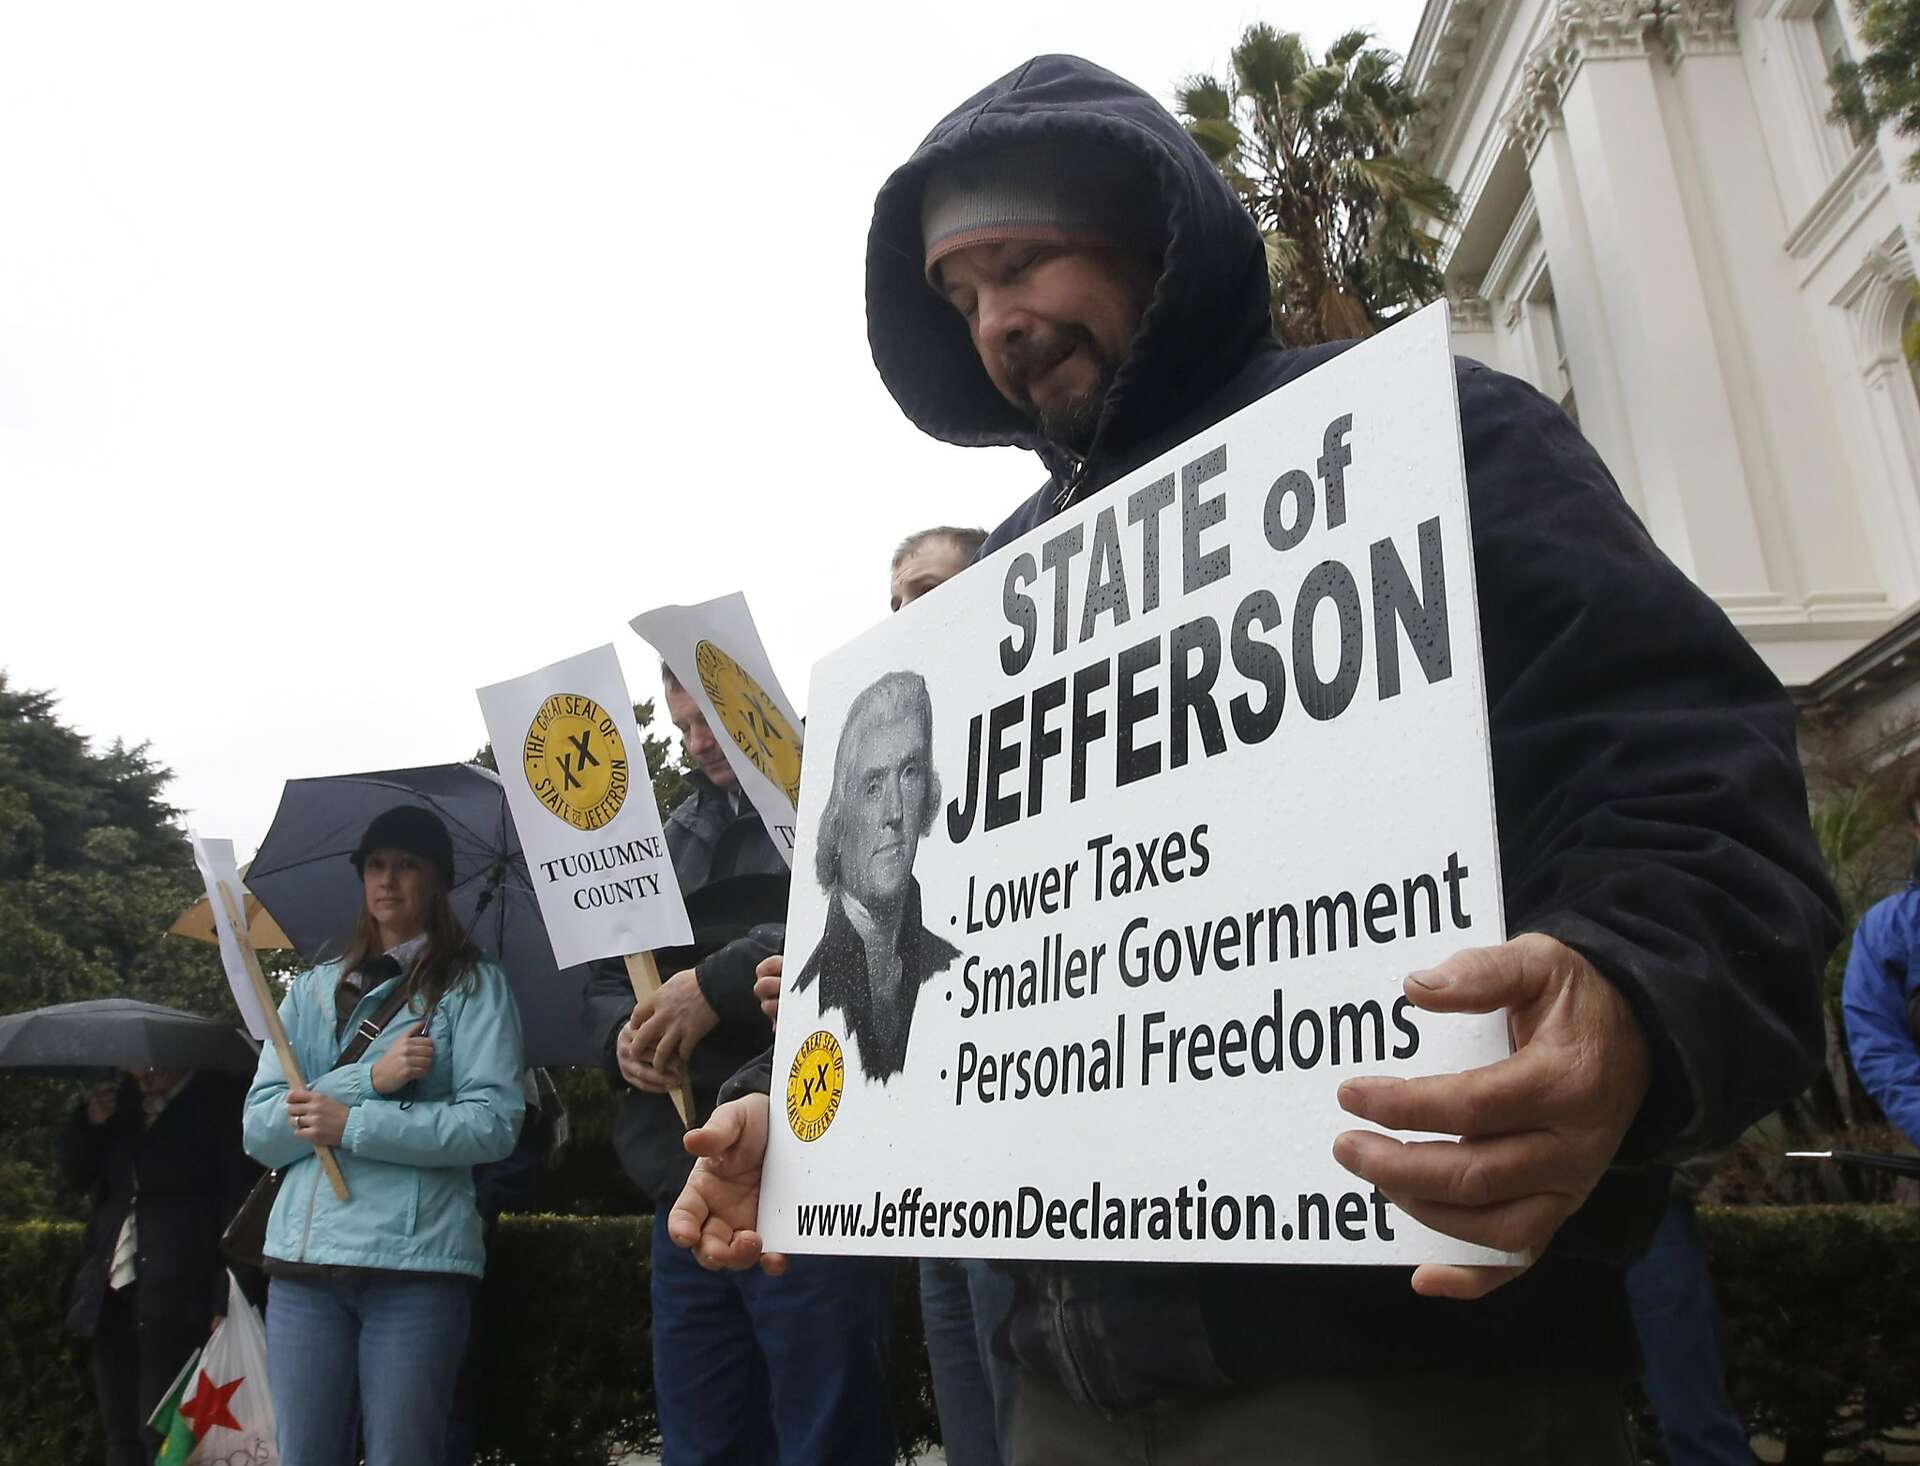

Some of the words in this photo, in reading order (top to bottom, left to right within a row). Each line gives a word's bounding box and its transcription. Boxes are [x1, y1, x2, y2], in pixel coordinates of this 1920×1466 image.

[999, 443, 1231, 677] STATE
[1263, 412, 1353, 551] of
[946, 515, 1453, 844] JEFFERSON
[526, 730, 546, 763] THE
[537, 696, 562, 732] GREAT
[565, 696, 597, 723] SEAL
[600, 718, 618, 740] OF
[535, 778, 571, 821] STATE
[585, 760, 627, 830] JEFFERSON
[540, 836, 663, 883] TUOLUMNE
[573, 873, 662, 911] COUNTY
[966, 860, 1079, 934] Lower
[1087, 823, 1210, 902] Taxes
[960, 933, 1106, 1018] Smaller
[1118, 852, 1472, 988] Government
[789, 1056, 802, 1080] THE
[801, 1034, 822, 1056] GREAT
[822, 1033, 839, 1058] SEAL
[956, 1013, 1126, 1106] Personal
[1140, 989, 1421, 1087] Freedoms
[787, 1095, 802, 1129] STATE
[805, 1088, 841, 1139] JEFFERSON
[796, 1179, 1396, 1242] www.JeffersonDeclaration.net
